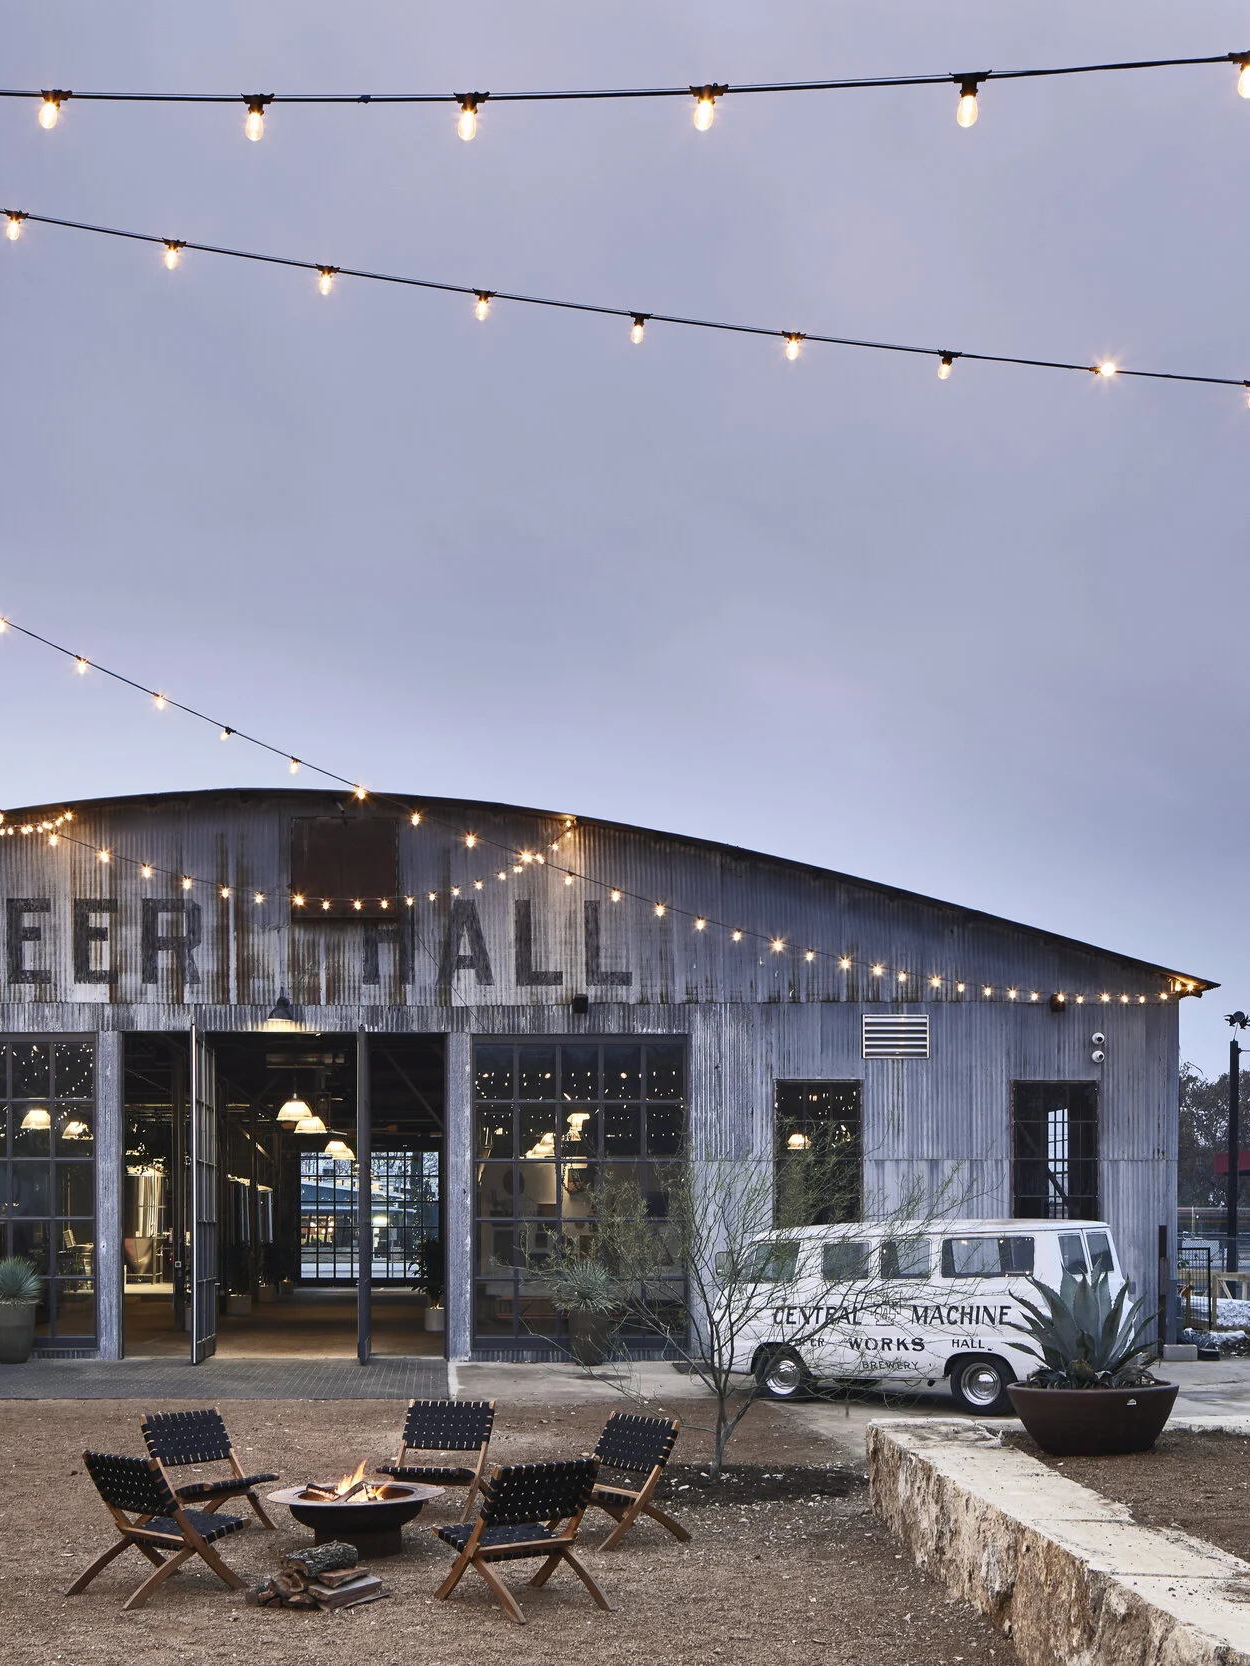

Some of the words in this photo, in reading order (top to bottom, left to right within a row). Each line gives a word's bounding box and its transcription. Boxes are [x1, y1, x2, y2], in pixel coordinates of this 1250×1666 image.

[363, 900, 632, 986] HALL
[773, 1306, 862, 1325] CENTRAL
[911, 1305, 1012, 1325] MACHINE
[848, 1338, 925, 1351] WORKS
[952, 1338, 985, 1349] HALL
[862, 1360, 919, 1370] BREWERY
